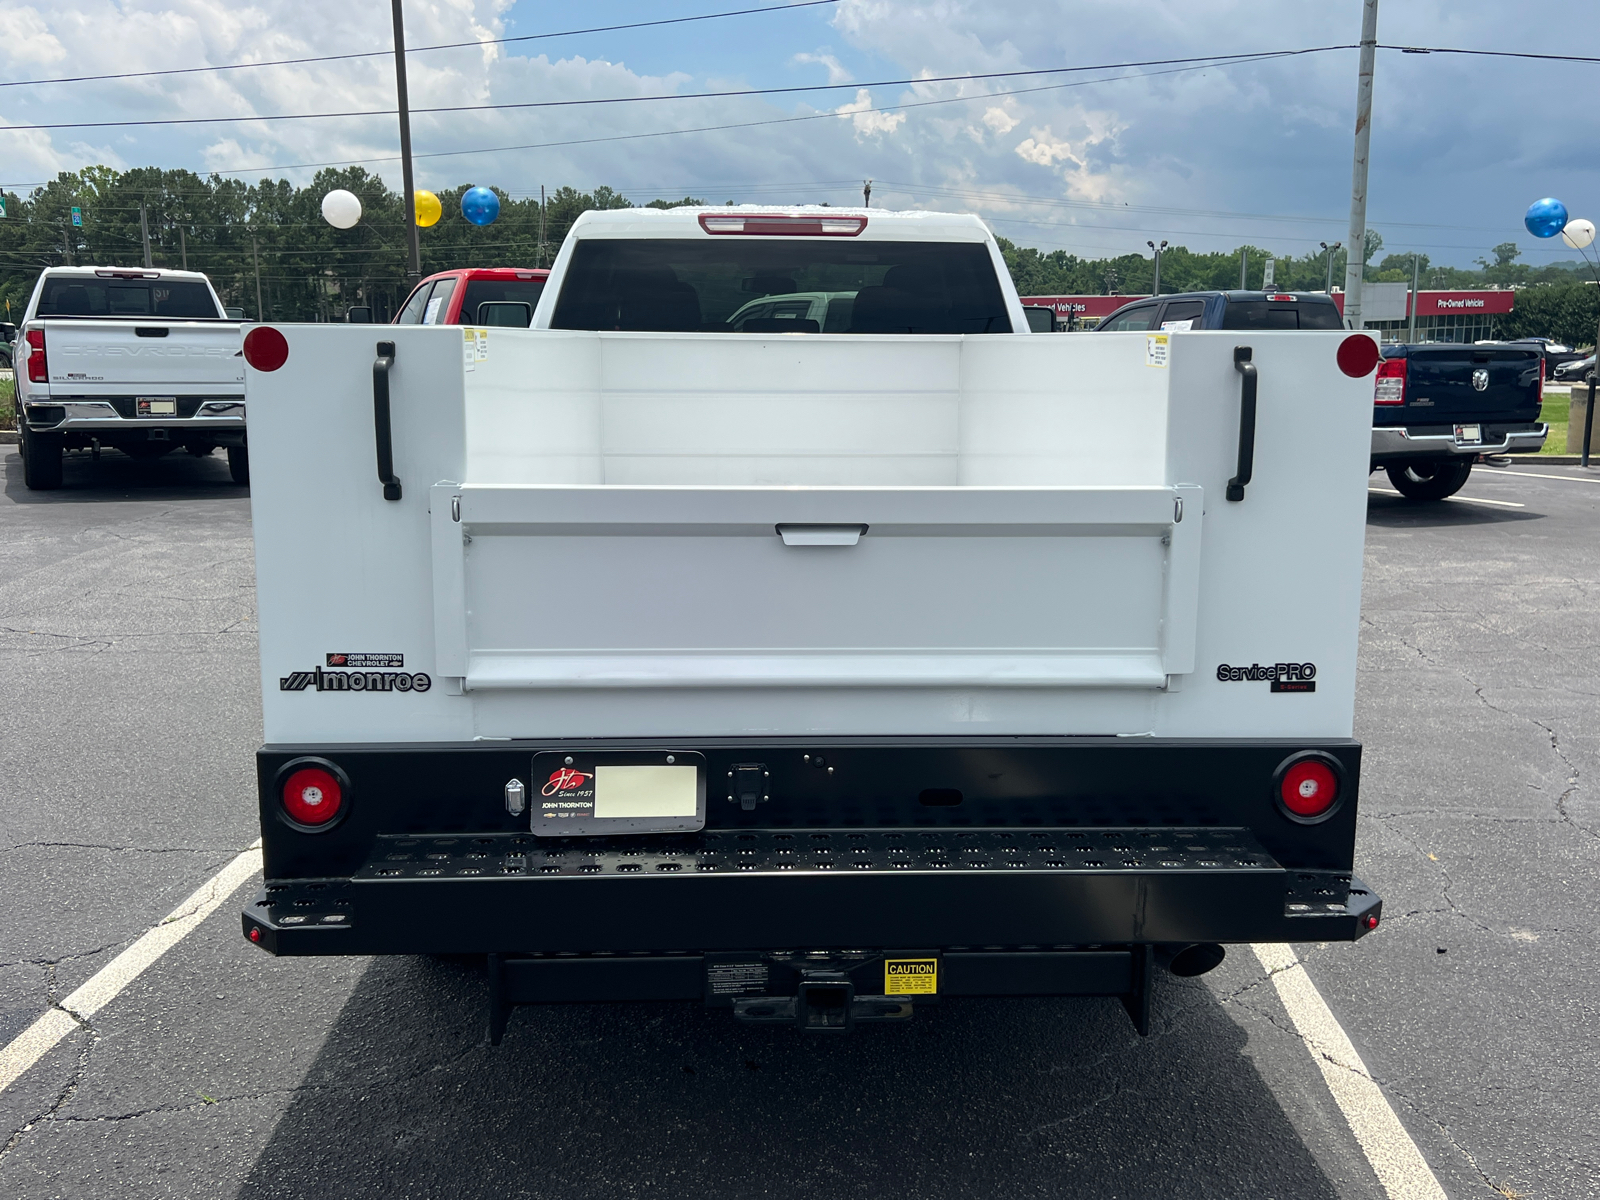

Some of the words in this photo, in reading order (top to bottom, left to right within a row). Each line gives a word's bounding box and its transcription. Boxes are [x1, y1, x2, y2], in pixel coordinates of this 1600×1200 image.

[1437, 299, 1464, 308] Pre-Owned
[1465, 299, 1484, 307] Vehicles
[1217, 663, 1316, 681] ServicePRO
[322, 671, 431, 692] monroe
[890, 964, 933, 973] CAUTION
